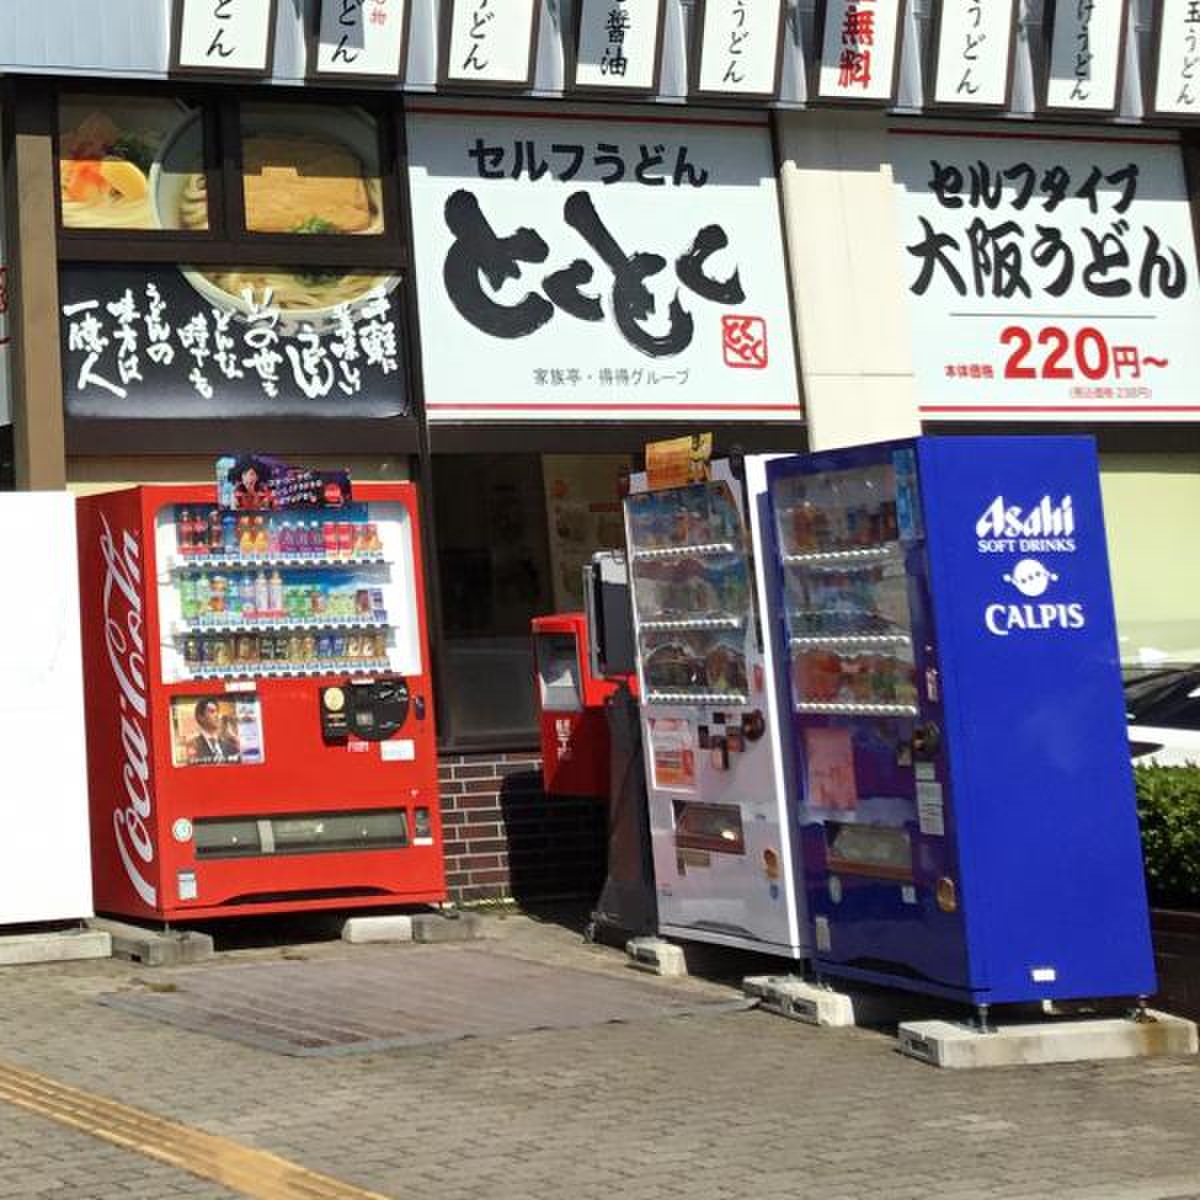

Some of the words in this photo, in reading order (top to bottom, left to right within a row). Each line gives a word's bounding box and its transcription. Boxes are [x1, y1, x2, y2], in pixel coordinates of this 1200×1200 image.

[468, 138, 709, 188] セルフうどん
[927, 159, 1140, 215] セルフタイプ
[443, 187, 747, 359] とくとく
[905, 215, 1188, 300] 大阪うどん
[975, 495, 1076, 539] Asahi
[977, 539, 1017, 553] SOFT
[1019, 538, 1077, 553] DRINKS
[984, 603, 1086, 636] CALPIS
